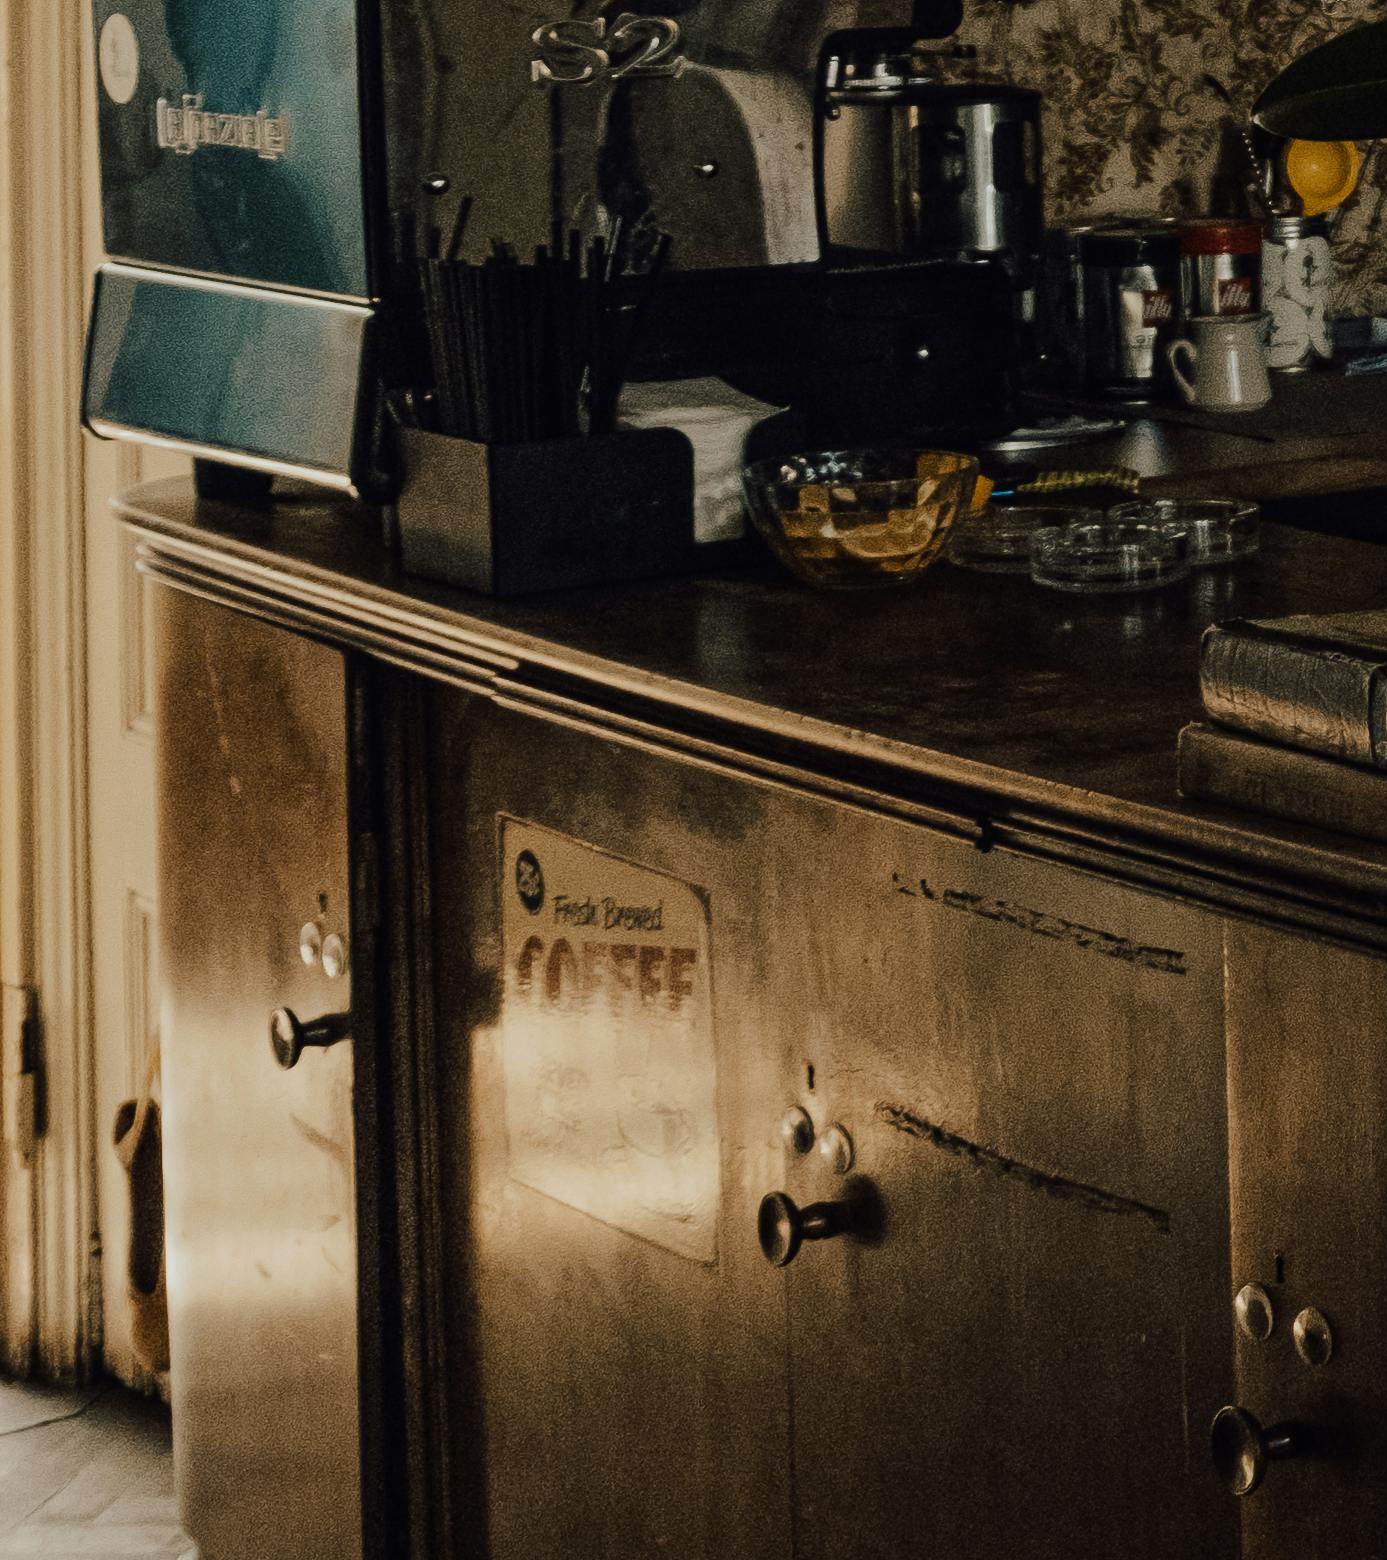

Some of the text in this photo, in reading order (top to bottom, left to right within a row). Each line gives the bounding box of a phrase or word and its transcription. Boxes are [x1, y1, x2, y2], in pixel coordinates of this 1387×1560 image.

[531, 12, 688, 84] S2
[1221, 282, 1251, 310] illy
[551, 894, 665, 931] Fresh Brewed
